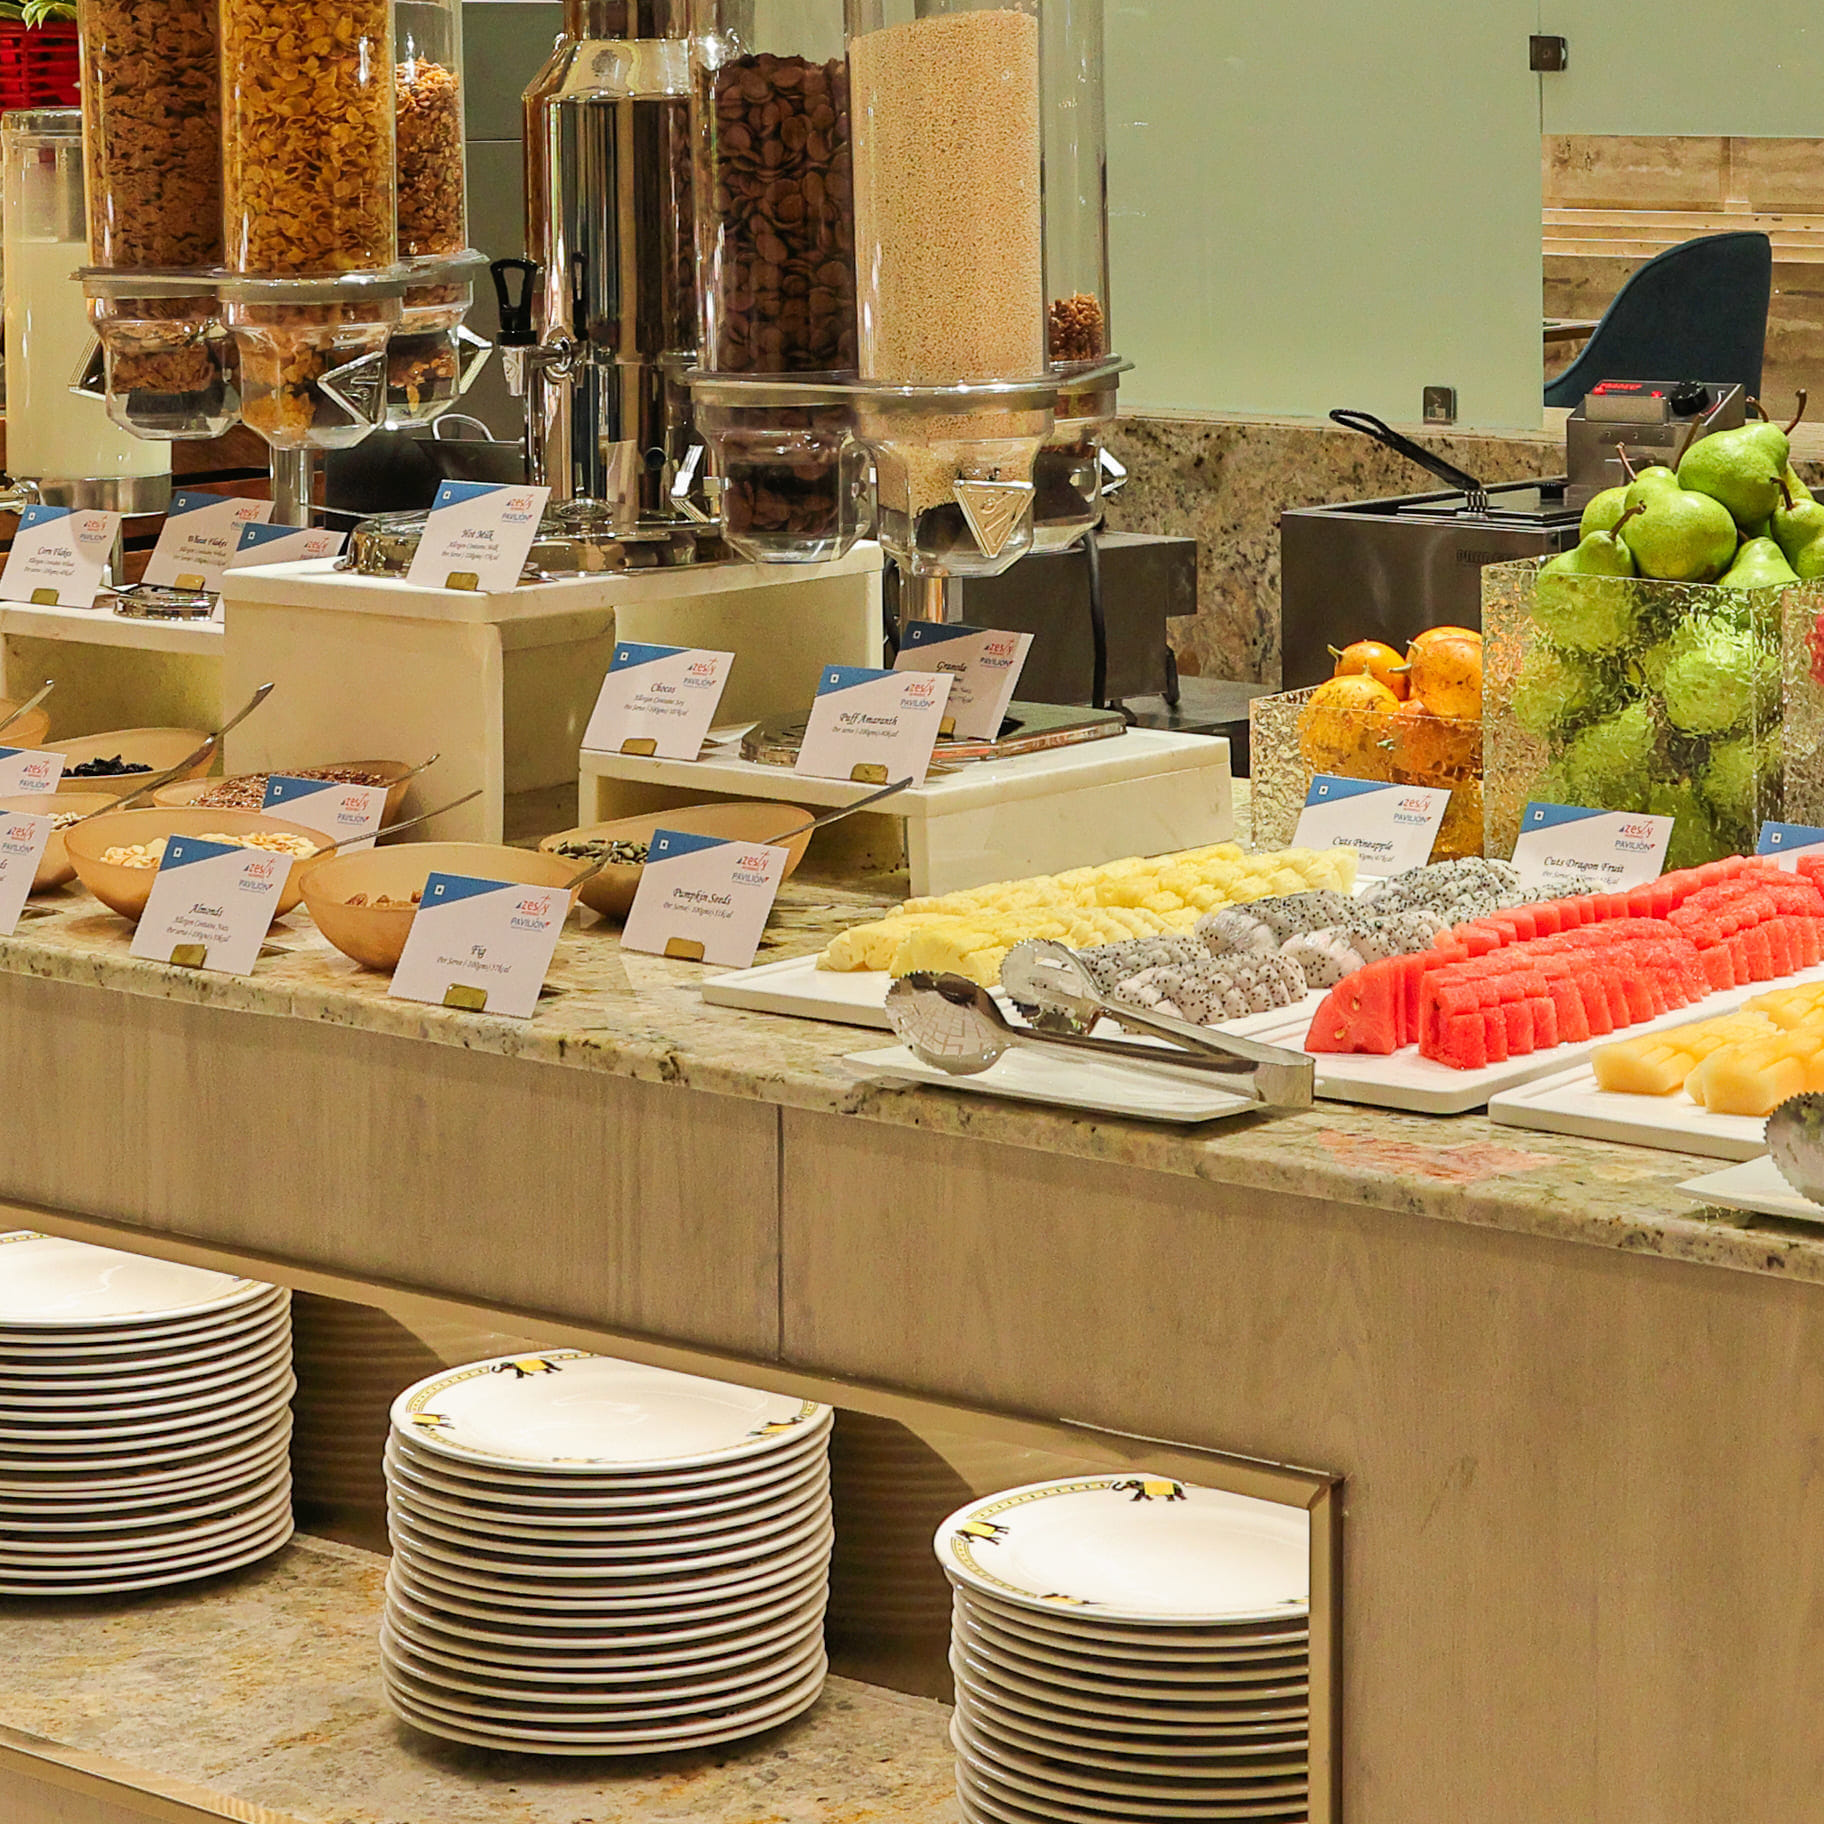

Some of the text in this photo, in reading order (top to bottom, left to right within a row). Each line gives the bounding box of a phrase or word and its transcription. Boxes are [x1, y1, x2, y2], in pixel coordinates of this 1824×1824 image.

[1332, 836, 1393, 852] Cuts Pineapple
[1544, 856, 1624, 873] Cuts Dragon Fruit
[673, 888, 732, 905] Pumpkin Seeds
[471, 945, 487, 959] Fig
